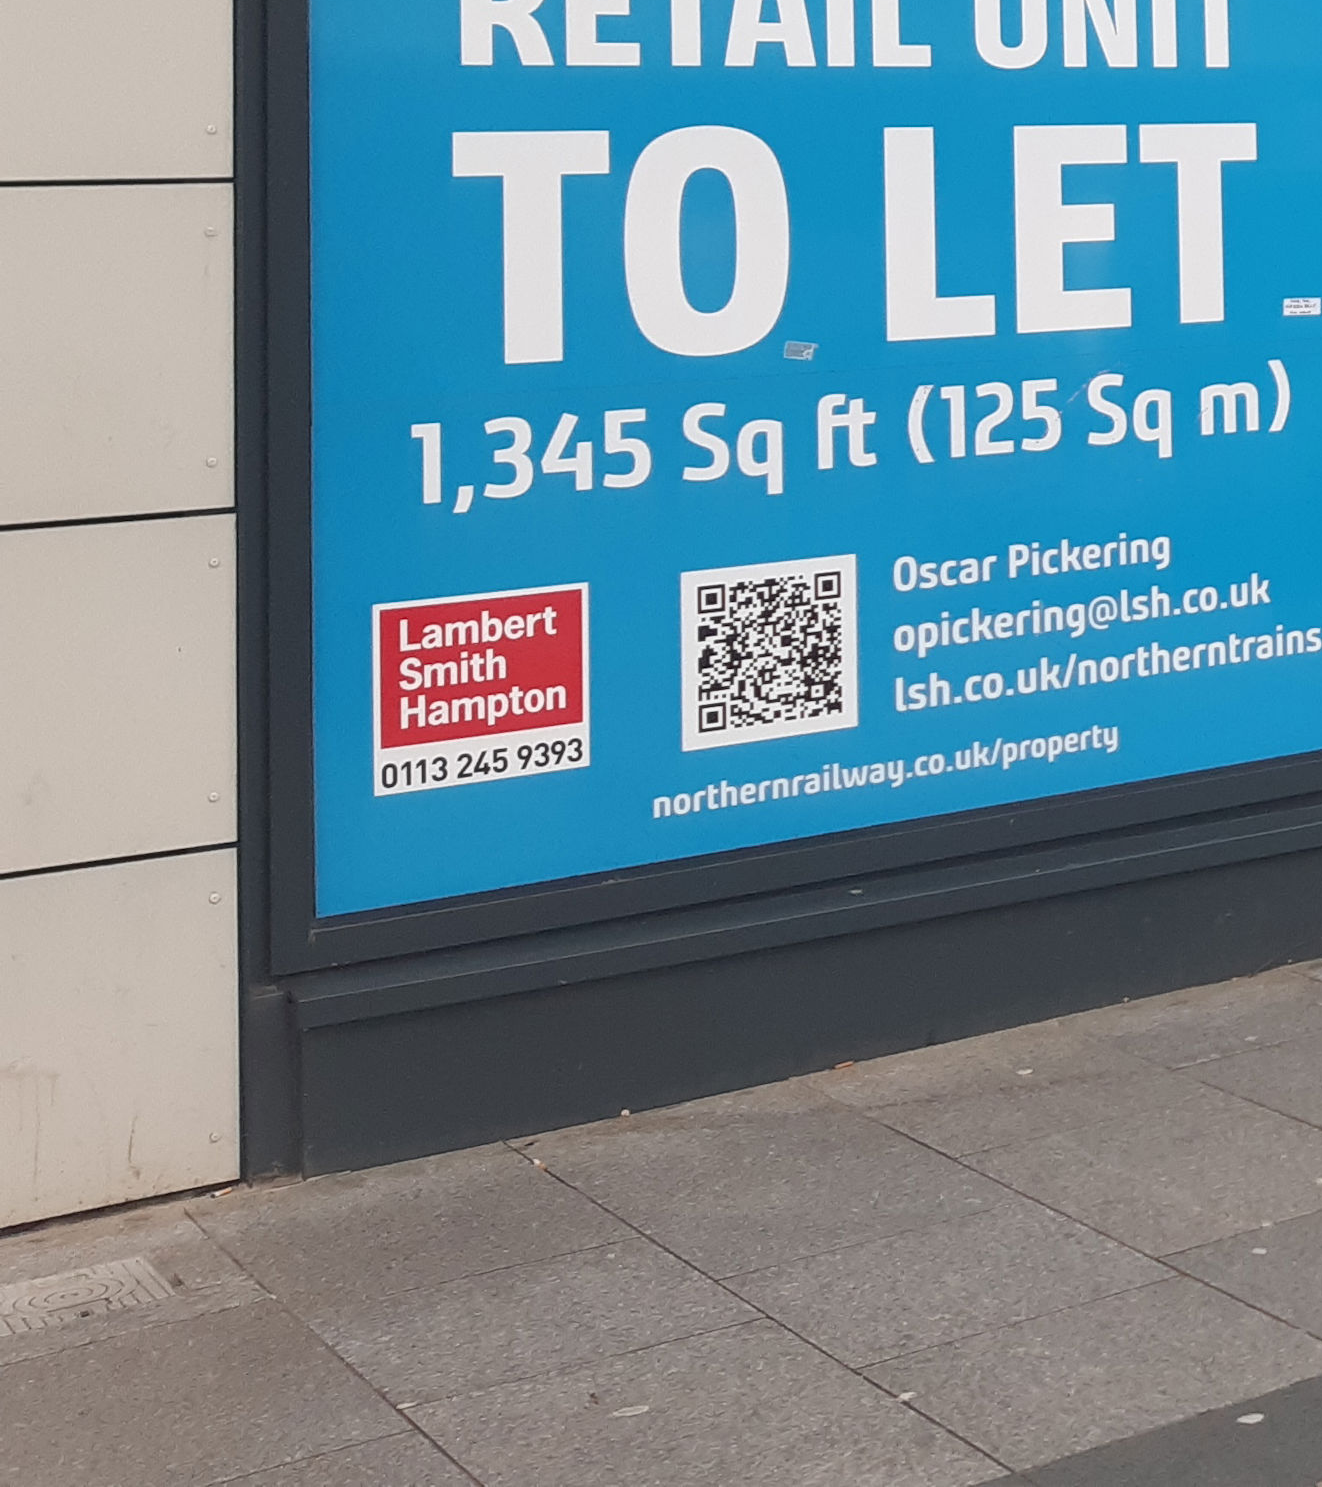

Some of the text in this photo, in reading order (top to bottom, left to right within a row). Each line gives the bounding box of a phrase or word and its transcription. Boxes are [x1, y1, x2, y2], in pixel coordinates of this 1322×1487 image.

[450, 121, 1259, 365] TO LET
[409, 359, 1291, 514] 1,345 Sq ft (125 Sq m)
[892, 535, 1171, 592] Oscar Pickering
[398, 605, 558, 652] Lambert
[892, 573, 1271, 659] opickering@lsh.co.uk
[397, 649, 508, 691] Smith
[399, 678, 568, 730] Hampton
[894, 626, 1322, 712] lsh.co.uk/northerntrains
[380, 737, 584, 790] 0113 245 9393
[651, 723, 1120, 819] northernrailway.co.uk/property
